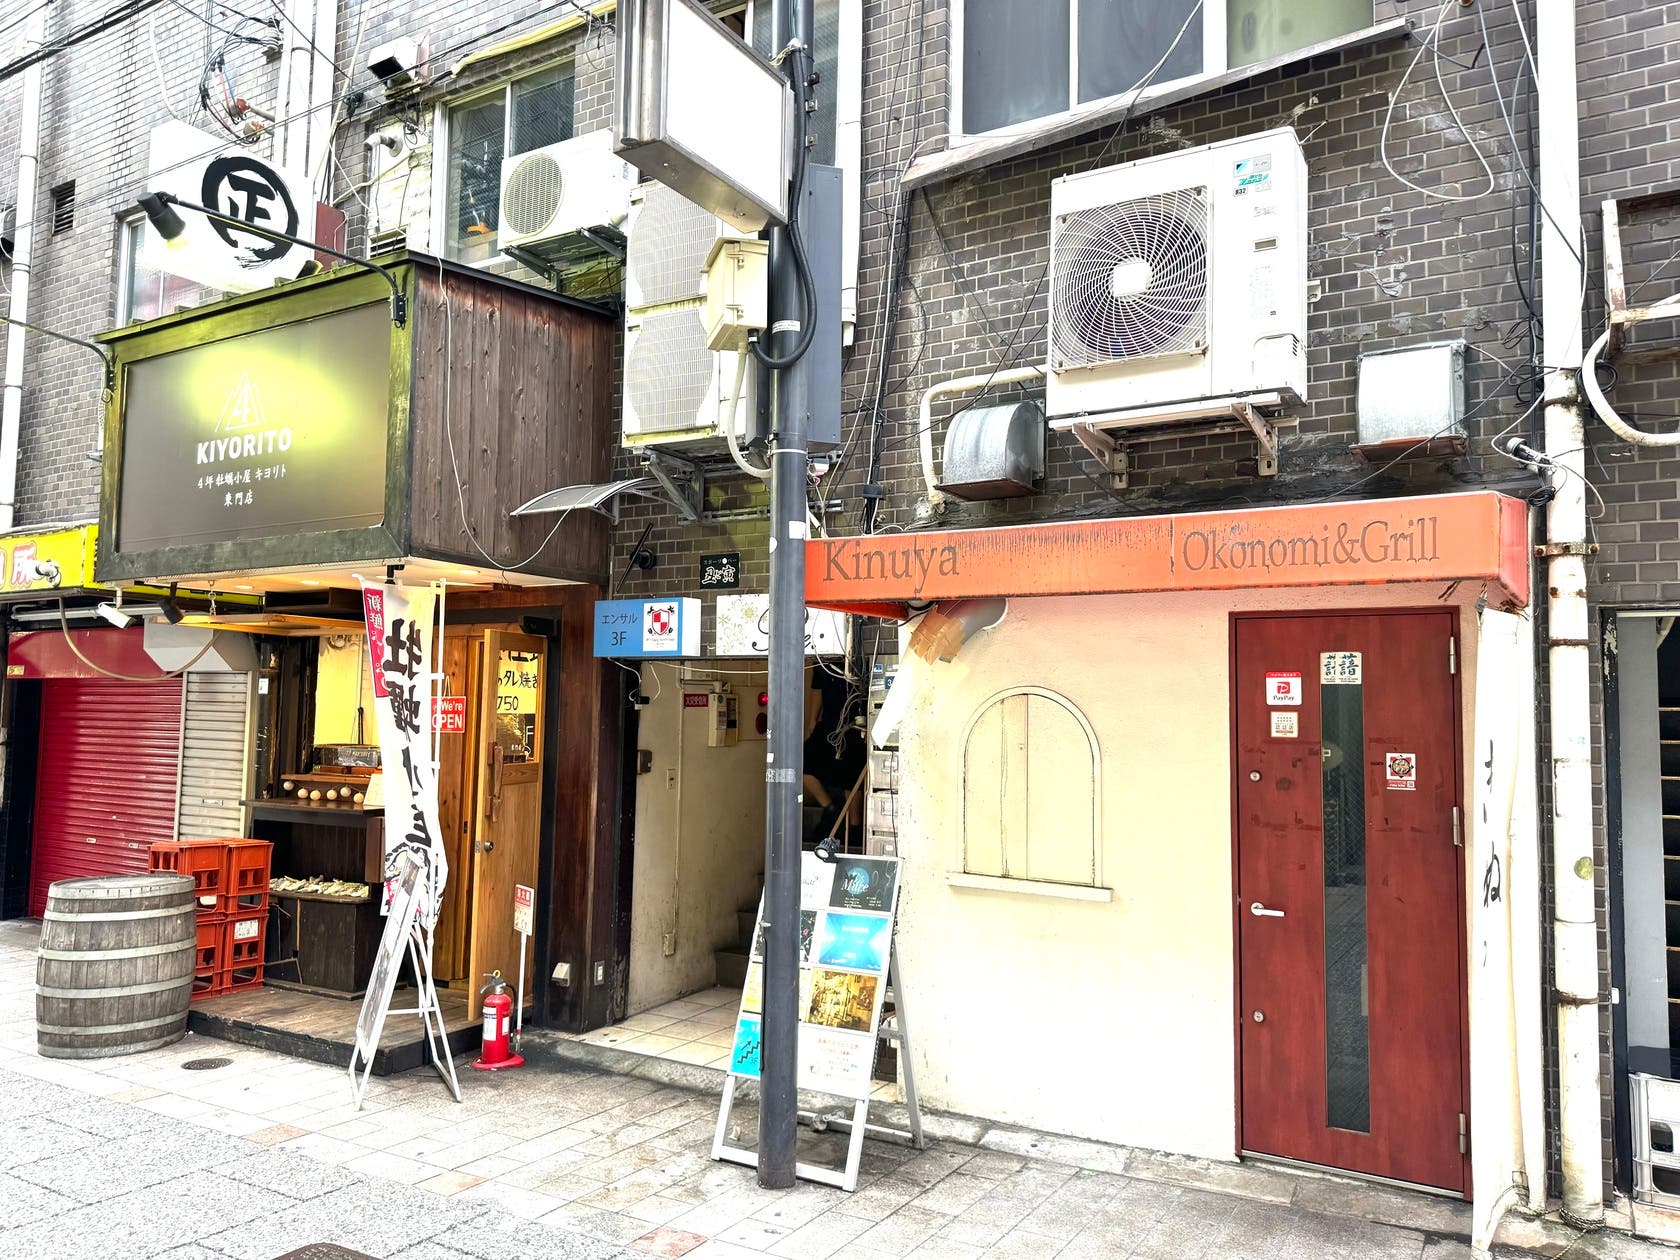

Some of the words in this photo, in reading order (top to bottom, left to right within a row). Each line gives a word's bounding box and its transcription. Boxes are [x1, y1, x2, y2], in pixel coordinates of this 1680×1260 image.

[196, 427, 293, 465] KIYORITO
[255, 463, 287, 481] キヨリト
[223, 490, 253, 507] 東門店
[1183, 517, 1440, 571] Okonomi&Grill
[823, 540, 959, 594] Kinuya
[602, 613, 637, 625] エンサル
[611, 631, 627, 646] 3F
[441, 700, 463, 711] We're
[497, 696, 519, 711] 750
[432, 714, 462, 728] OPEN
